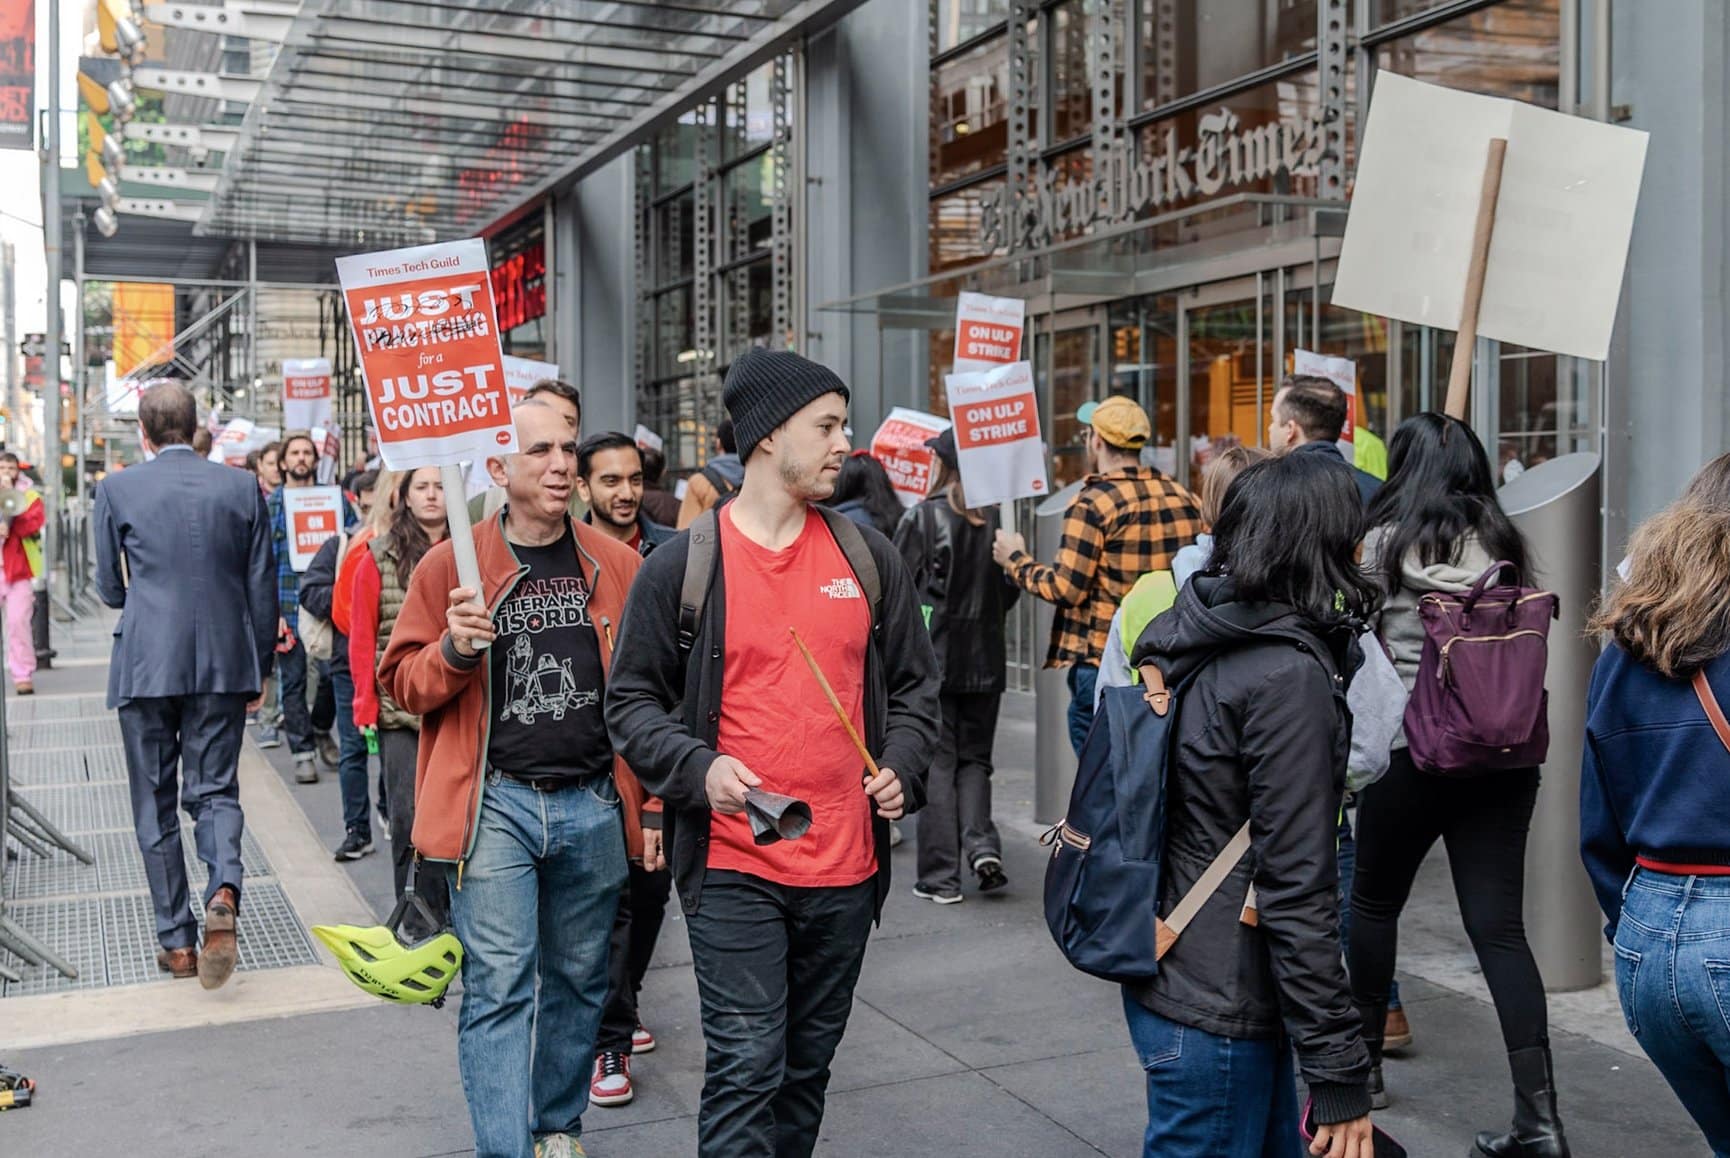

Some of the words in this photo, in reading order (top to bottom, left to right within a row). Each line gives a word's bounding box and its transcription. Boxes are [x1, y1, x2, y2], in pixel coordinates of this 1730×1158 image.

[1036, 164, 1099, 238] New
[1099, 127, 1193, 222] York
[1194, 106, 1327, 195] Times
[367, 267, 401, 278] Times
[402, 260, 429, 273] Tech
[431, 256, 460, 269] Guild
[360, 284, 481, 325] JUST
[968, 325, 990, 340] ON
[991, 328, 1014, 343] ULP
[418, 353, 434, 369] for
[436, 353, 443, 363] a
[968, 342, 1011, 359] STRIKE
[378, 364, 495, 404] JUST
[382, 391, 500, 431] CONTRACT
[966, 407, 993, 424] ON
[994, 401, 1025, 419] ULP
[970, 420, 1027, 441] STRIKE
[307, 515, 325, 530] ON
[820, 585, 847, 594] NORTH
[831, 578, 847, 586] THE
